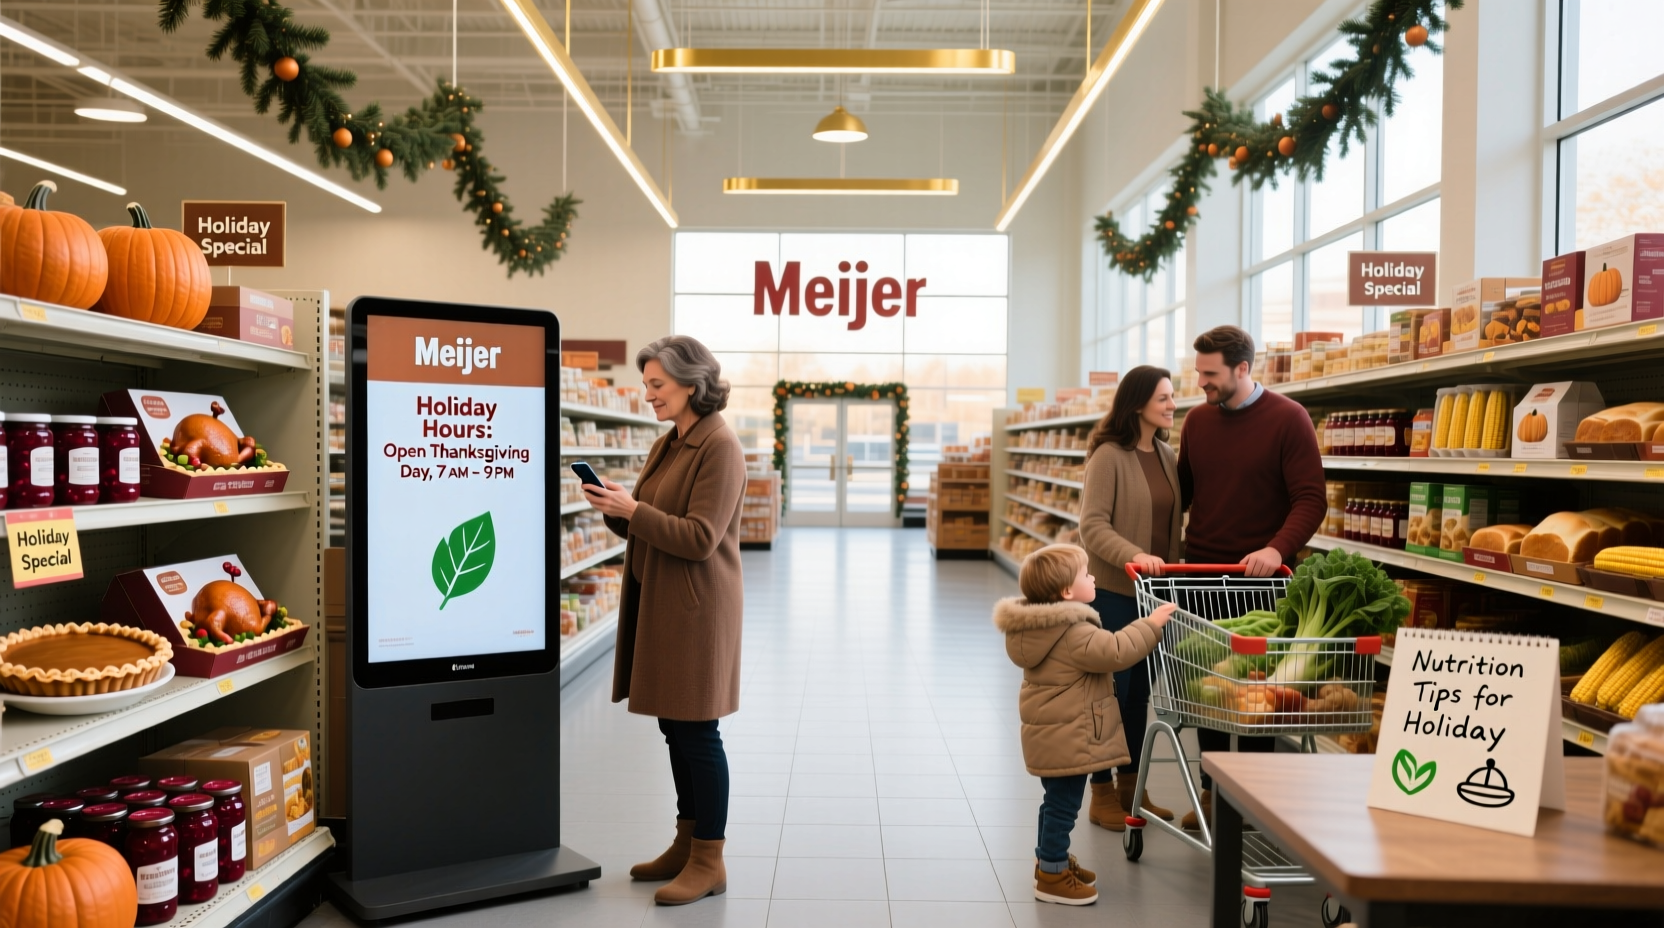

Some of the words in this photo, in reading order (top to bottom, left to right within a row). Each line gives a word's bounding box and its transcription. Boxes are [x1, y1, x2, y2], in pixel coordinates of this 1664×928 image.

[198, 216, 271, 238] Holiday
[201, 238, 267, 258] Special
[1361, 262, 1425, 280] Holiday
[754, 260, 927, 331] Meijer
[1364, 281, 1421, 299] Special
[415, 336, 501, 375] Meijer
[417, 396, 497, 422] Holiday
[423, 419, 493, 439] Hours:
[384, 443, 426, 462] Open
[430, 443, 530, 463] Thanksgiving
[400, 464, 433, 481] Day,
[17, 528, 70, 547] Holiday
[21, 548, 72, 573] Special
[1412, 650, 1524, 678] Nutrition
[1413, 681, 1462, 711] Tips
[1473, 684, 1514, 711] for
[1403, 710, 1506, 752] Holiday
